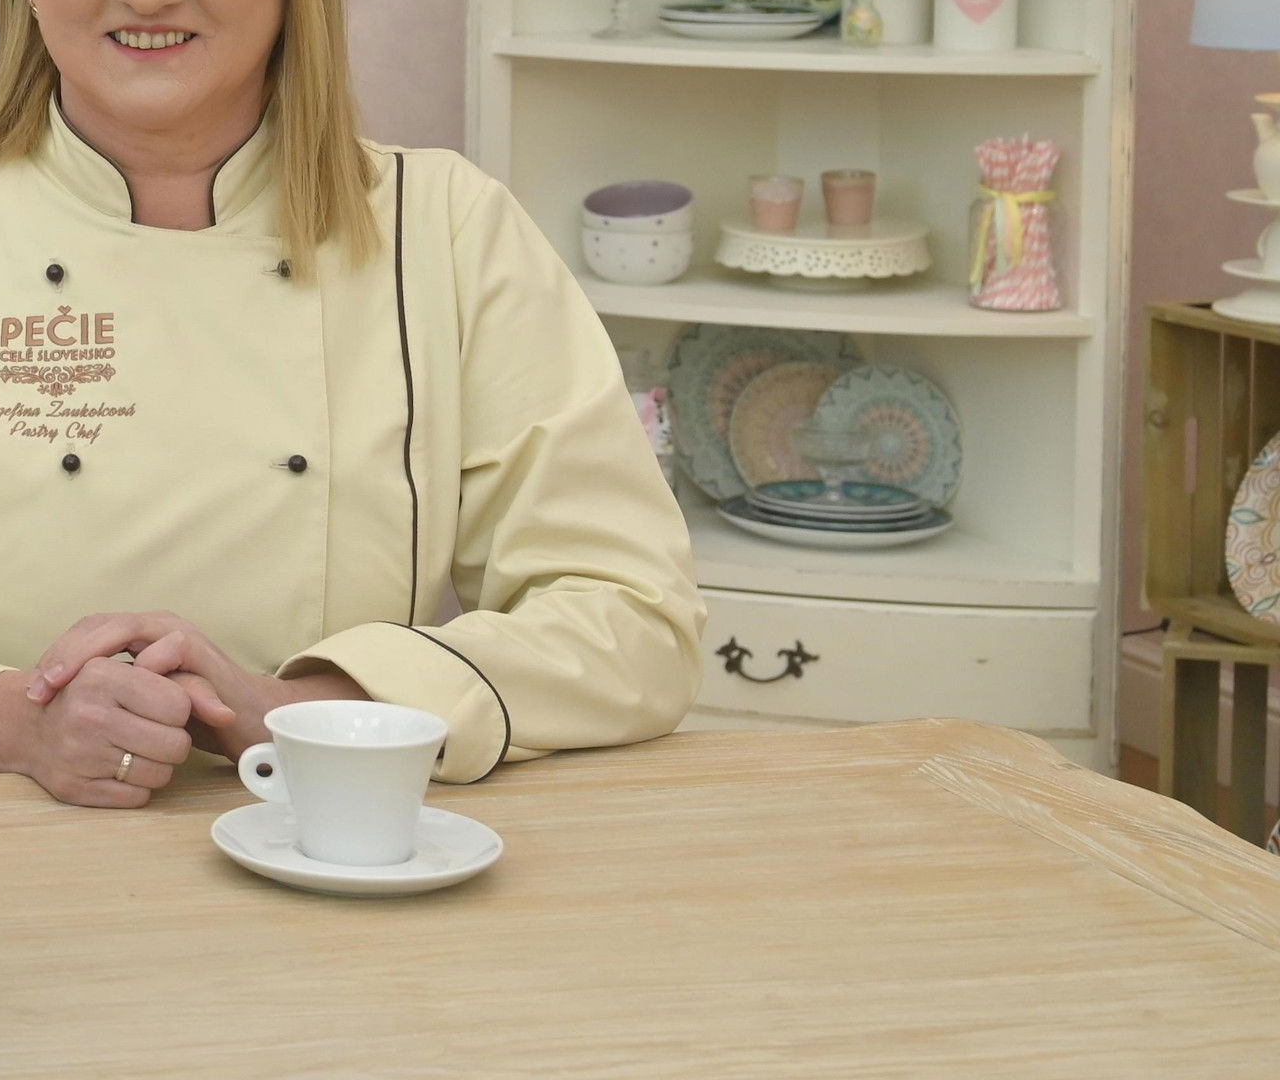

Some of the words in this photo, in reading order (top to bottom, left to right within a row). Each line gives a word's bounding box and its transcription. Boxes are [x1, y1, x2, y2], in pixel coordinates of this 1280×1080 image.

[0, 305, 114, 347] PEČIE
[37, 347, 116, 362] SLOVENSKO
[10, 420, 59, 444] Pastry
[65, 421, 103, 445] Chef
